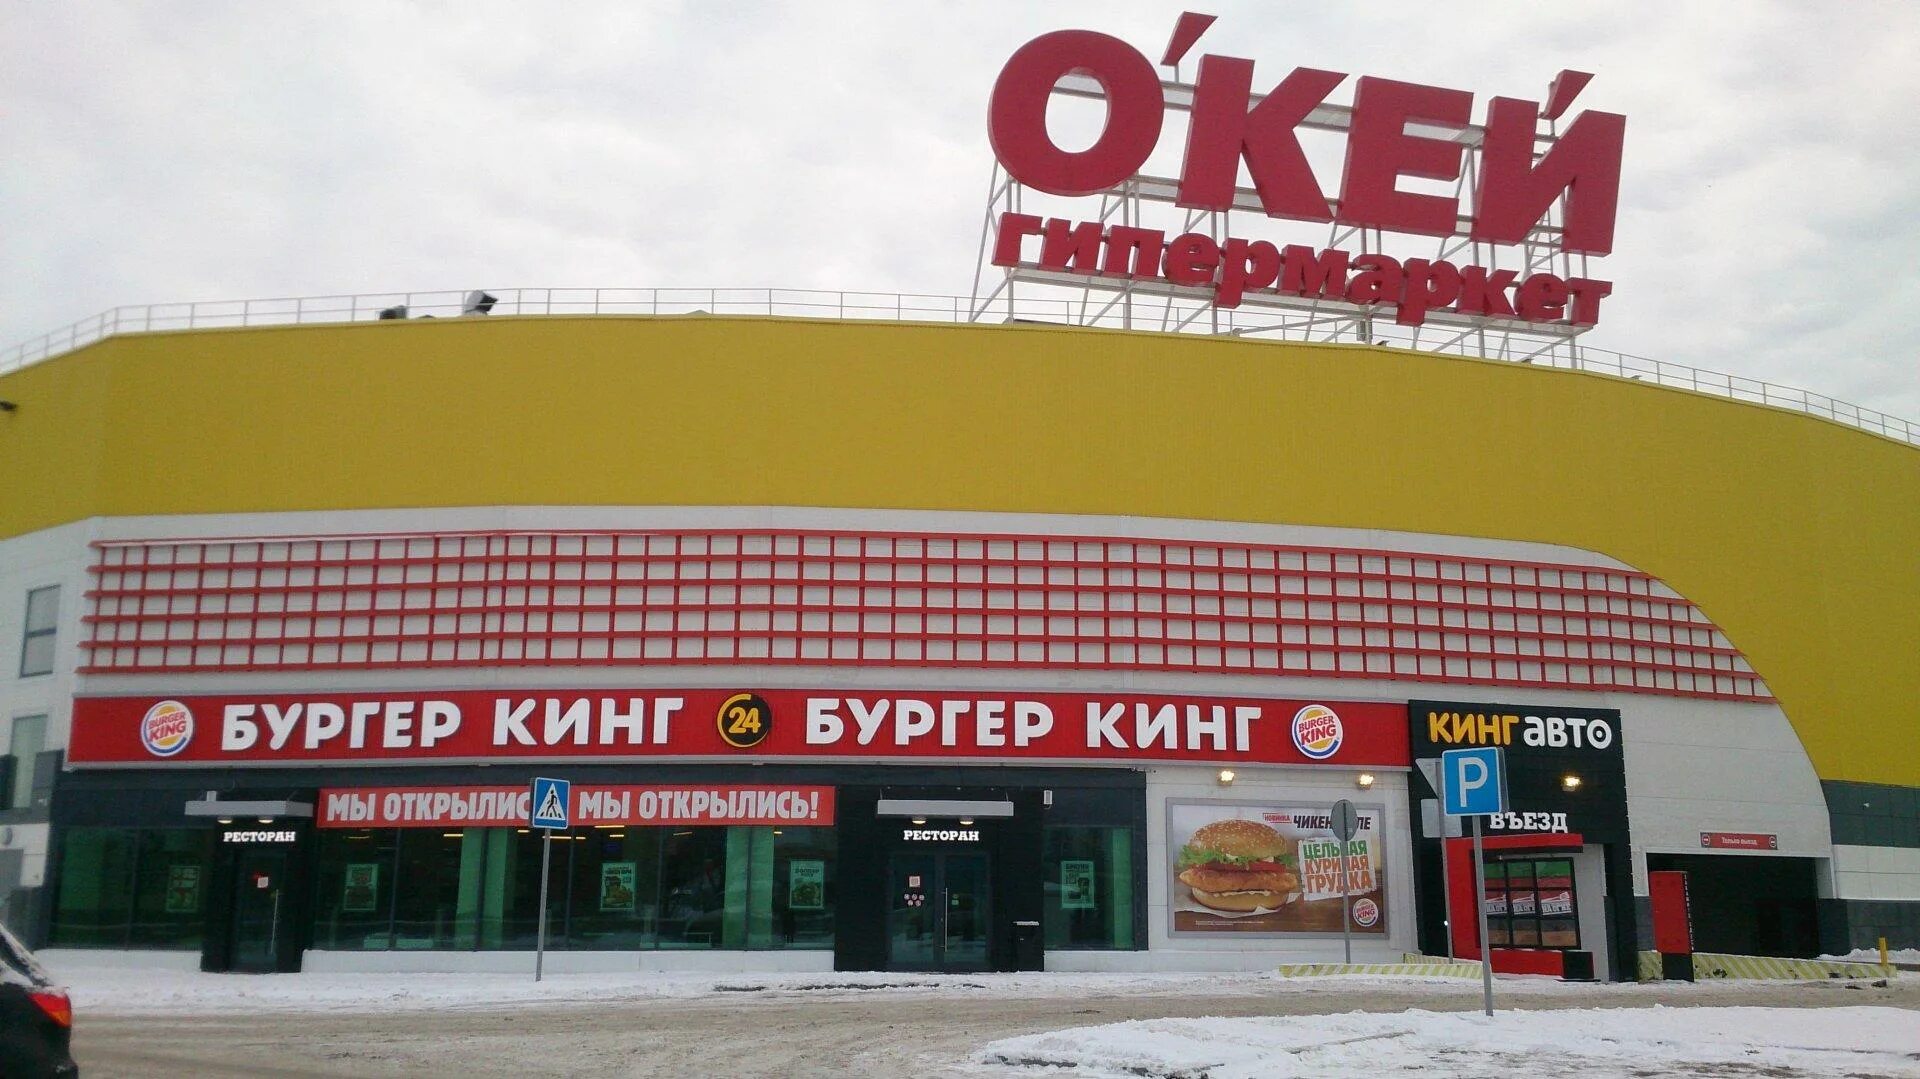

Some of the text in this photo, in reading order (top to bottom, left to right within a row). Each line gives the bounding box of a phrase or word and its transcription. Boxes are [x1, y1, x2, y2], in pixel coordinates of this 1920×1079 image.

[991, 212, 1612, 327] гипермаркет
[149, 711, 186, 730] BURGER
[150, 720, 187, 742] KING
[221, 698, 684, 751] БУРГЕР КИНГ
[728, 707, 761, 734] 24
[806, 698, 1261, 751] БУРГЕР КИНГ
[1298, 715, 1335, 733] BURGER
[1429, 712, 1519, 745] КИНГ
[1301, 724, 1337, 746] KING
[1458, 757, 1488, 808] P
[327, 791, 530, 821] МЫ ОТКРЫЛИС
[578, 790, 818, 819] МЫ ОТКРЫЛИСЬ!
[1489, 812, 1569, 834] ВЪЕЗД
[223, 831, 296, 843] РЕСТОРАН
[903, 830, 980, 842] РЕСТОРАН
[1303, 840, 1368, 860] ЦЕЛЬАЯ
